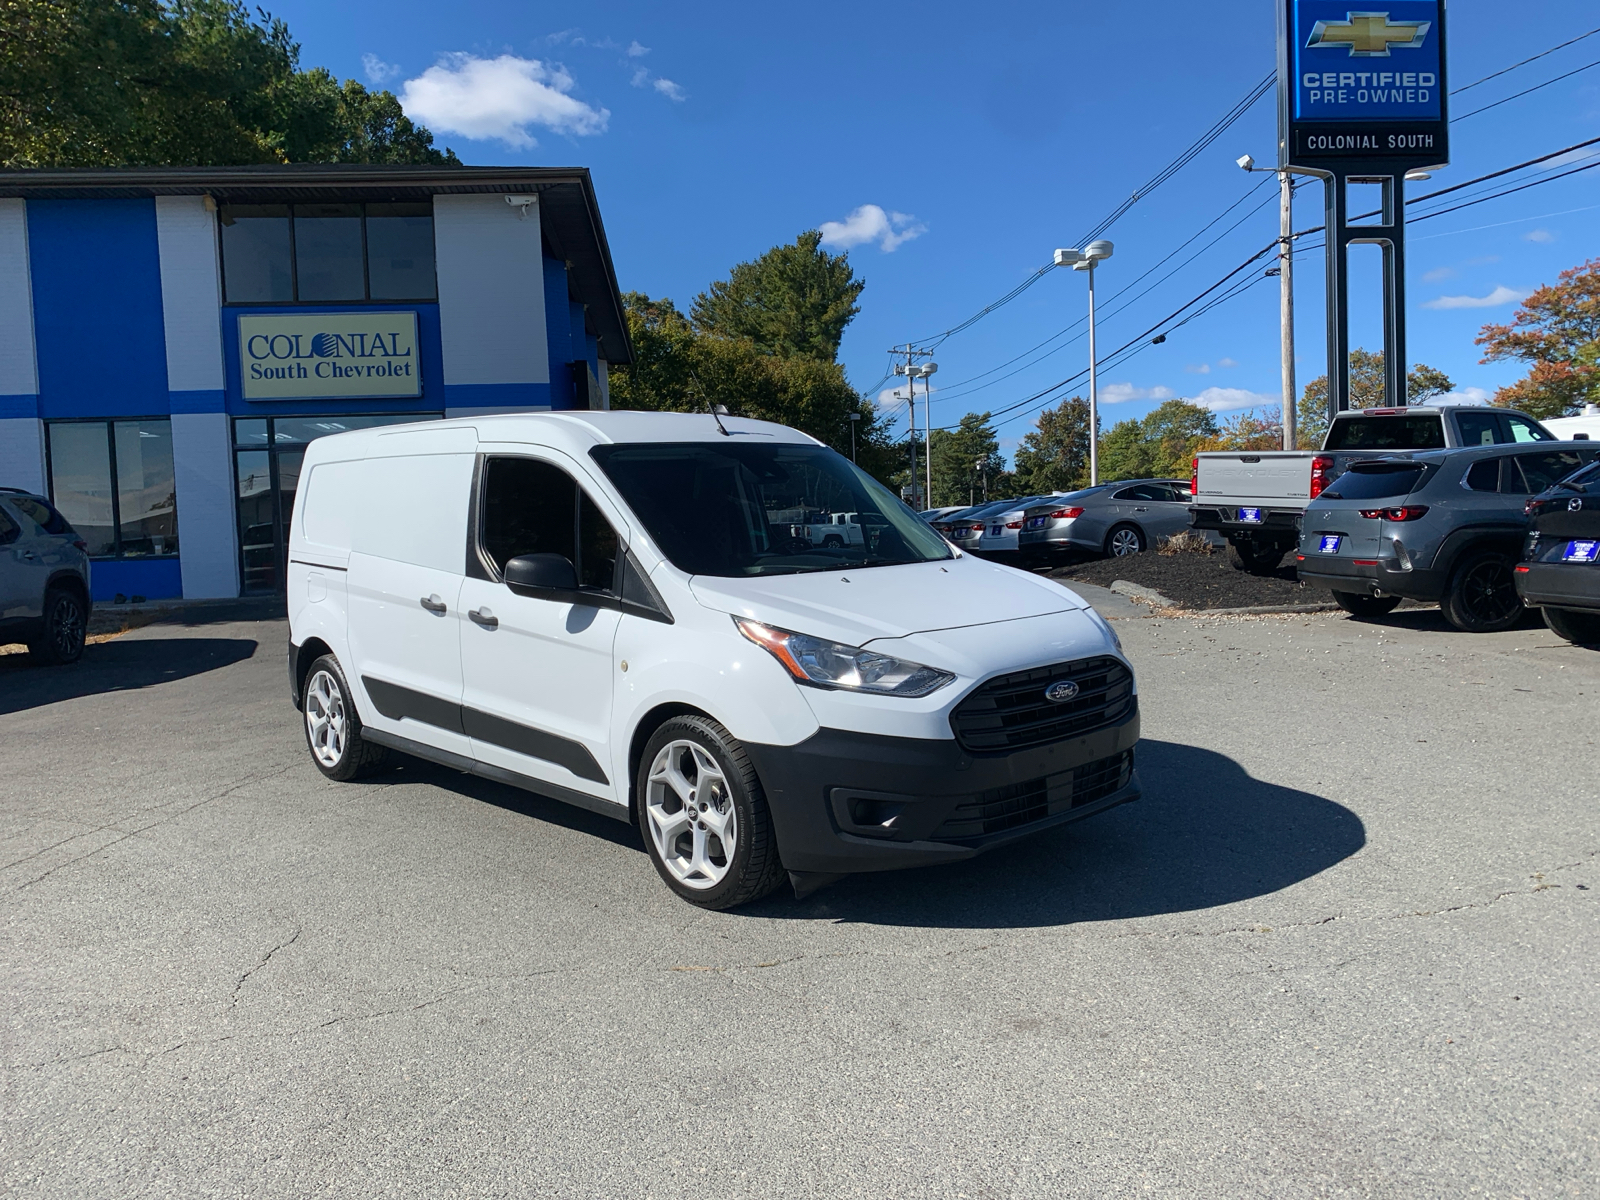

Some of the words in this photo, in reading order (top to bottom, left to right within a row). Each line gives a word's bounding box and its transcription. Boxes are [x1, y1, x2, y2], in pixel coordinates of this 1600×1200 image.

[1303, 72, 1436, 88] CERTIFIED
[1310, 89, 1430, 104] PRE-OWNED
[1307, 135, 1379, 149] COLONIAL
[1388, 134, 1434, 148] SOUTH
[247, 332, 411, 360] COLONIAL
[250, 362, 309, 380] South
[314, 360, 412, 379] Chevrolet
[1203, 468, 1303, 478] CHEVROLET
